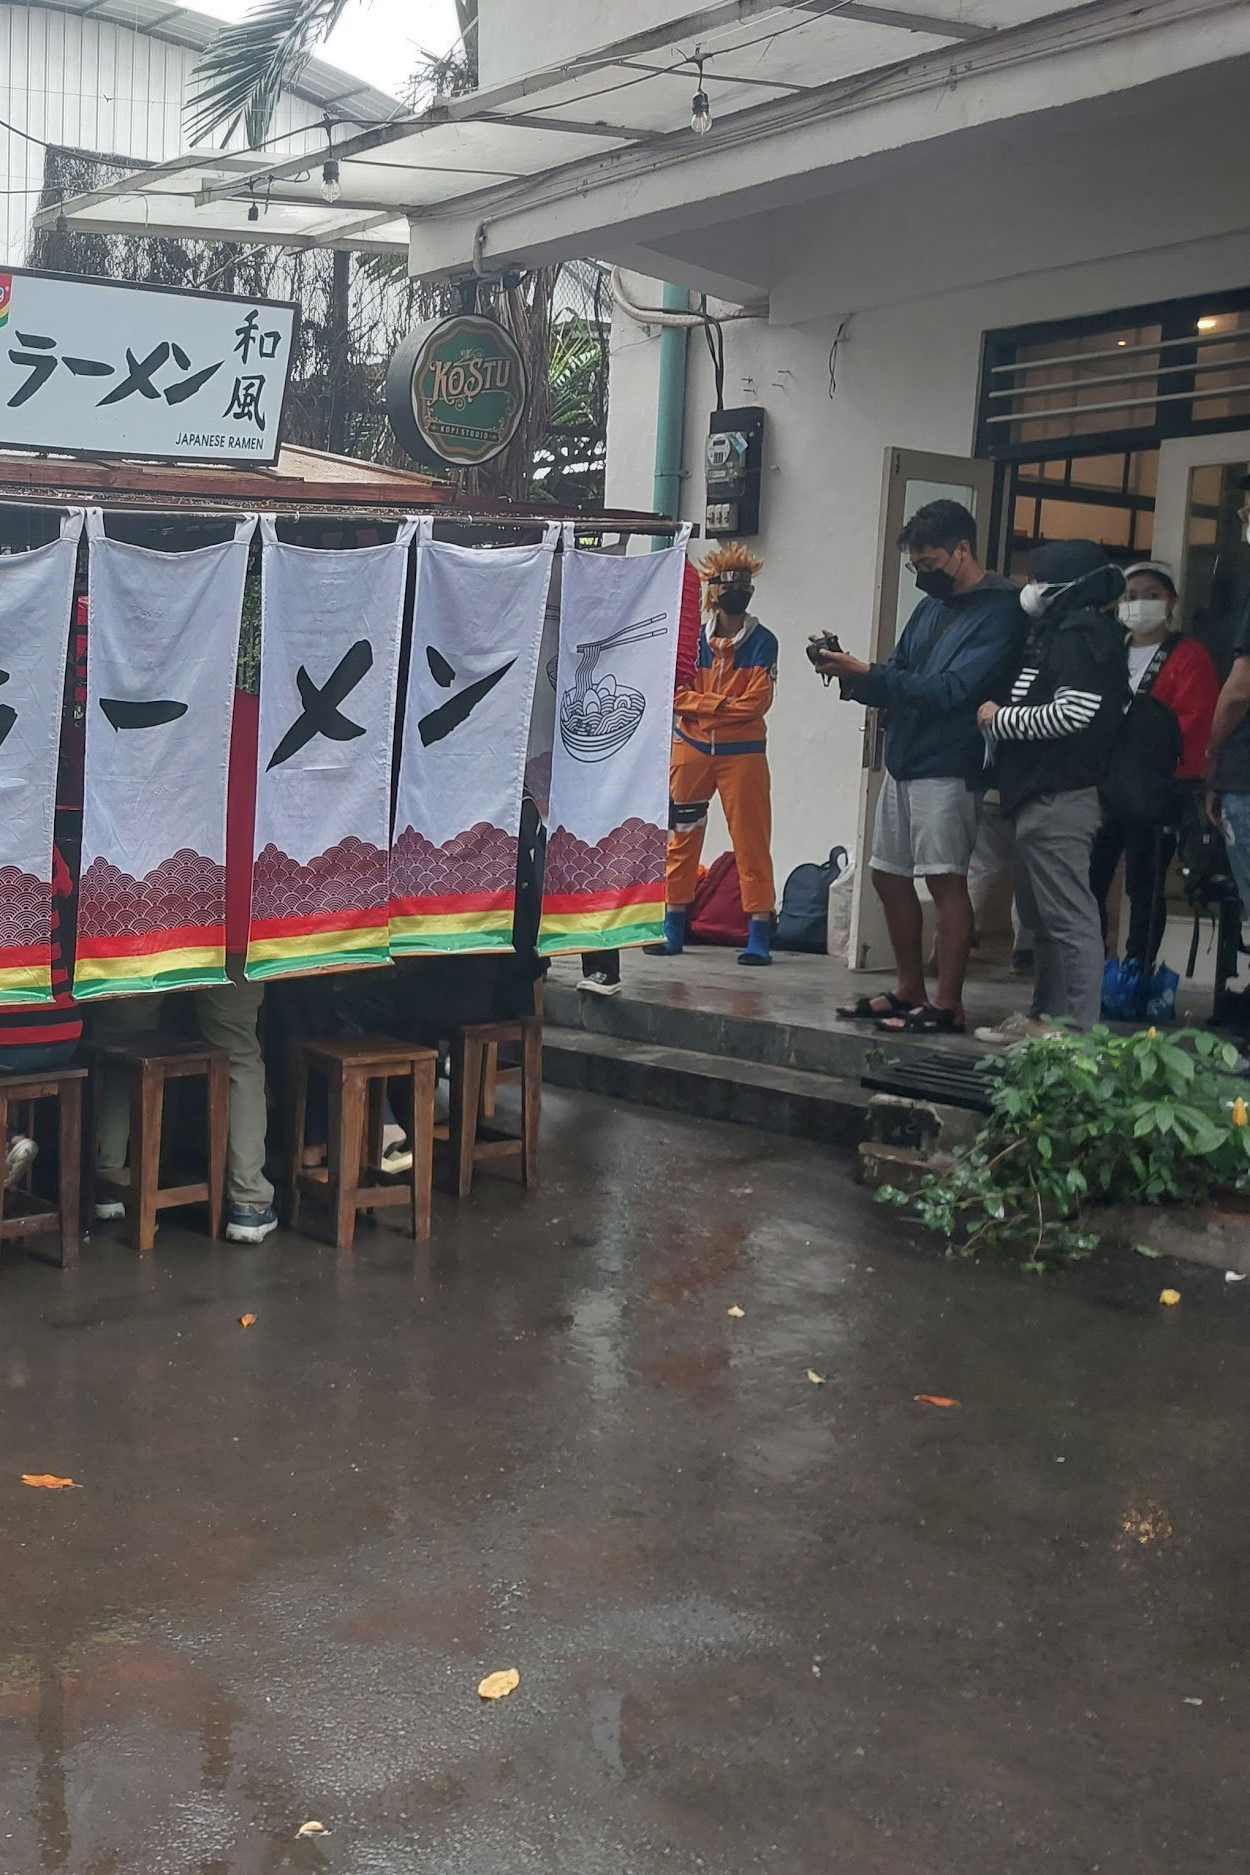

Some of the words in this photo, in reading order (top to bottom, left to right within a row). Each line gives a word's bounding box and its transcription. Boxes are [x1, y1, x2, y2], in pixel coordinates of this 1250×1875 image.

[7, 330, 226, 407] ラーメン
[222, 309, 282, 431] 和風
[176, 432, 226, 448] JAPANESE
[228, 436, 264, 450] RAMEN
